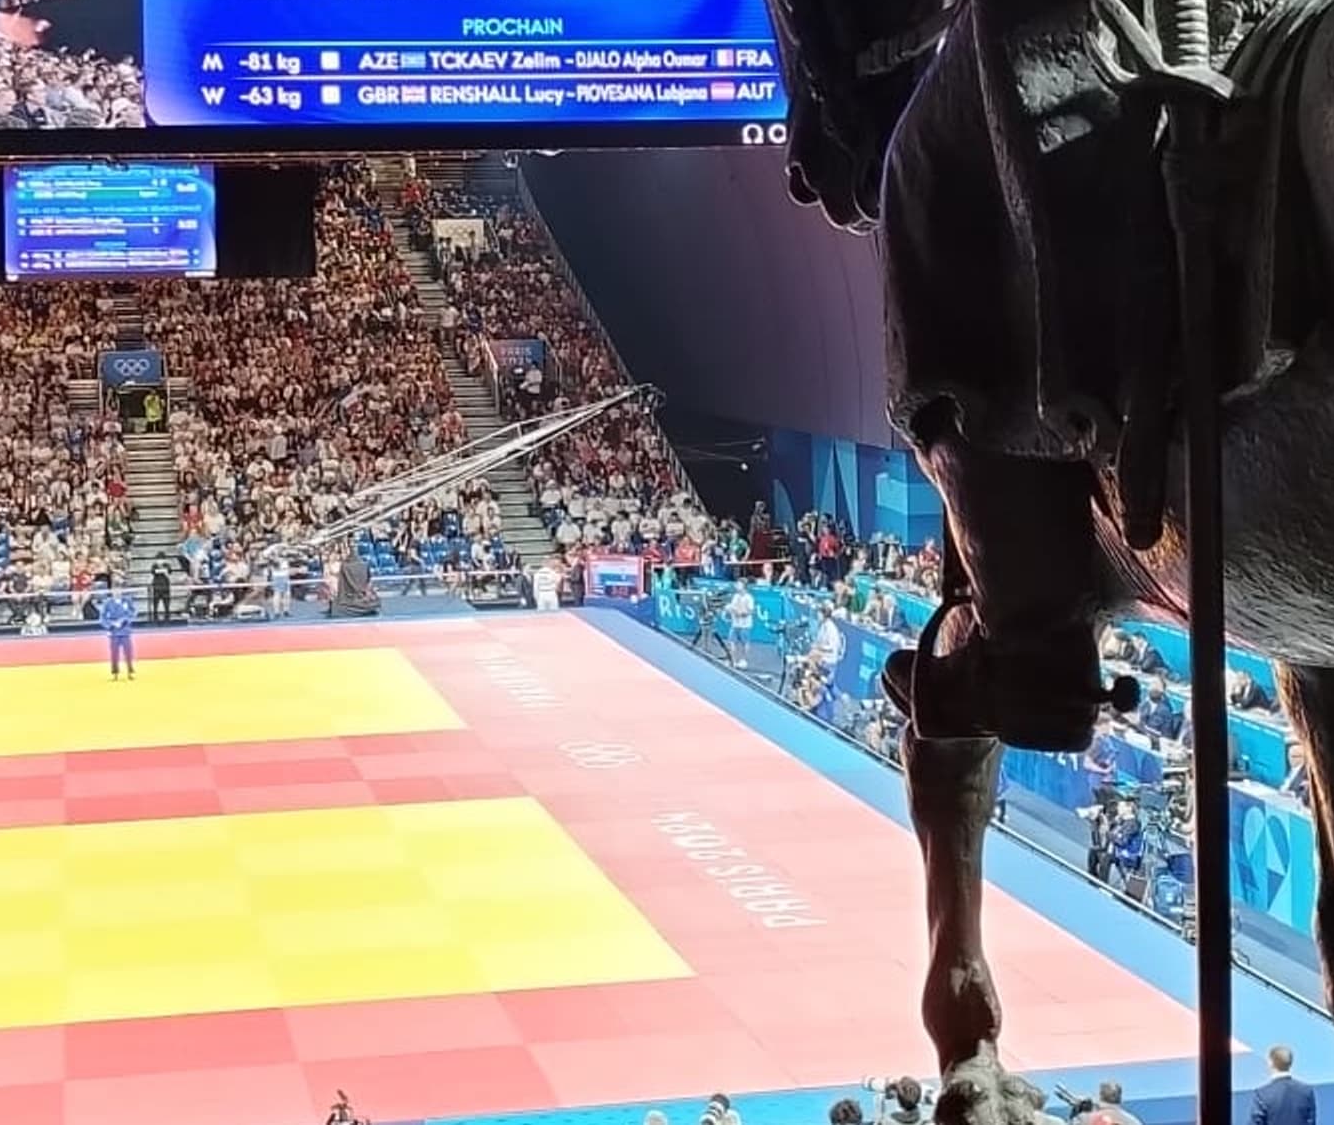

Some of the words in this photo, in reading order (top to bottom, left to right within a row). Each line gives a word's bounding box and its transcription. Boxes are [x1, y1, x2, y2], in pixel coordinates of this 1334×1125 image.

[462, 17, 564, 36] PROCHAIN
[201, 53, 224, 71] M
[239, 52, 272, 71] -81
[276, 52, 302, 75] kg
[358, 51, 399, 70] AZE
[429, 51, 508, 70] TCKAEV
[622, 49, 662, 73] Alpha
[736, 48, 774, 67] FRA
[201, 86, 225, 105] W
[239, 87, 273, 106] -63
[276, 86, 302, 110] kg
[358, 85, 400, 105] GBR
[430, 84, 523, 104] RENSHALL
[524, 84, 565, 107] Lucy
[737, 81, 776, 101] AUT
[704, 864, 828, 928] PARIS
